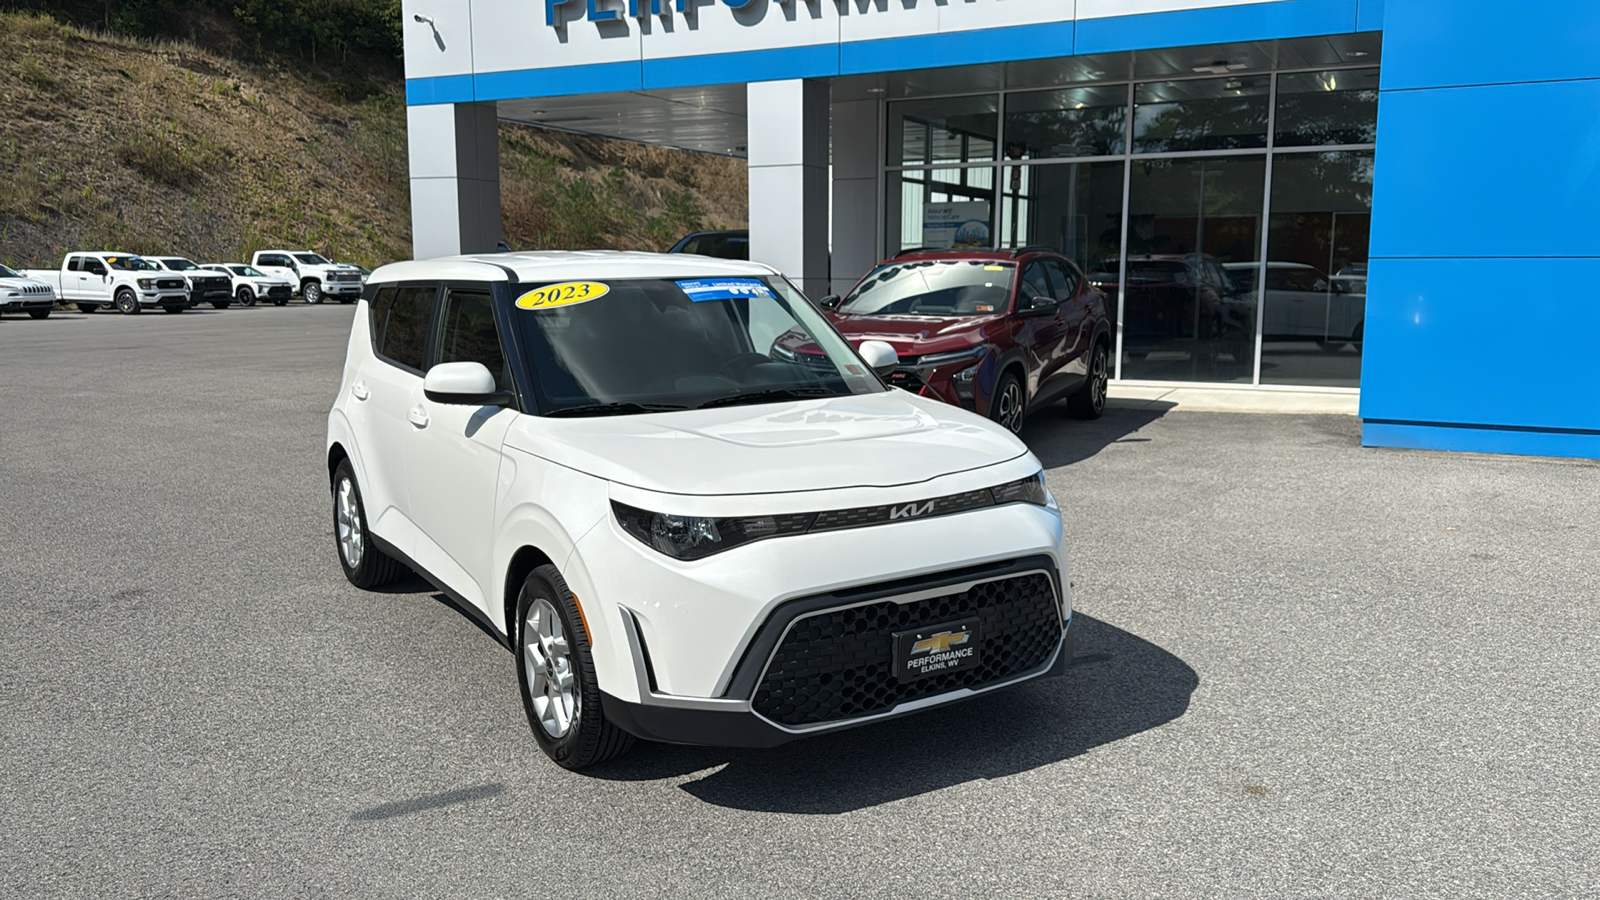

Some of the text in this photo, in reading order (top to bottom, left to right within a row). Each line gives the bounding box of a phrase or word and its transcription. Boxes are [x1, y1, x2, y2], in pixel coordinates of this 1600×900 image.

[533, 284, 590, 306] 2023
[890, 500, 934, 520] KIA
[907, 647, 973, 669] PERFORMANCE
[921, 659, 959, 673] ELKINS, WV
